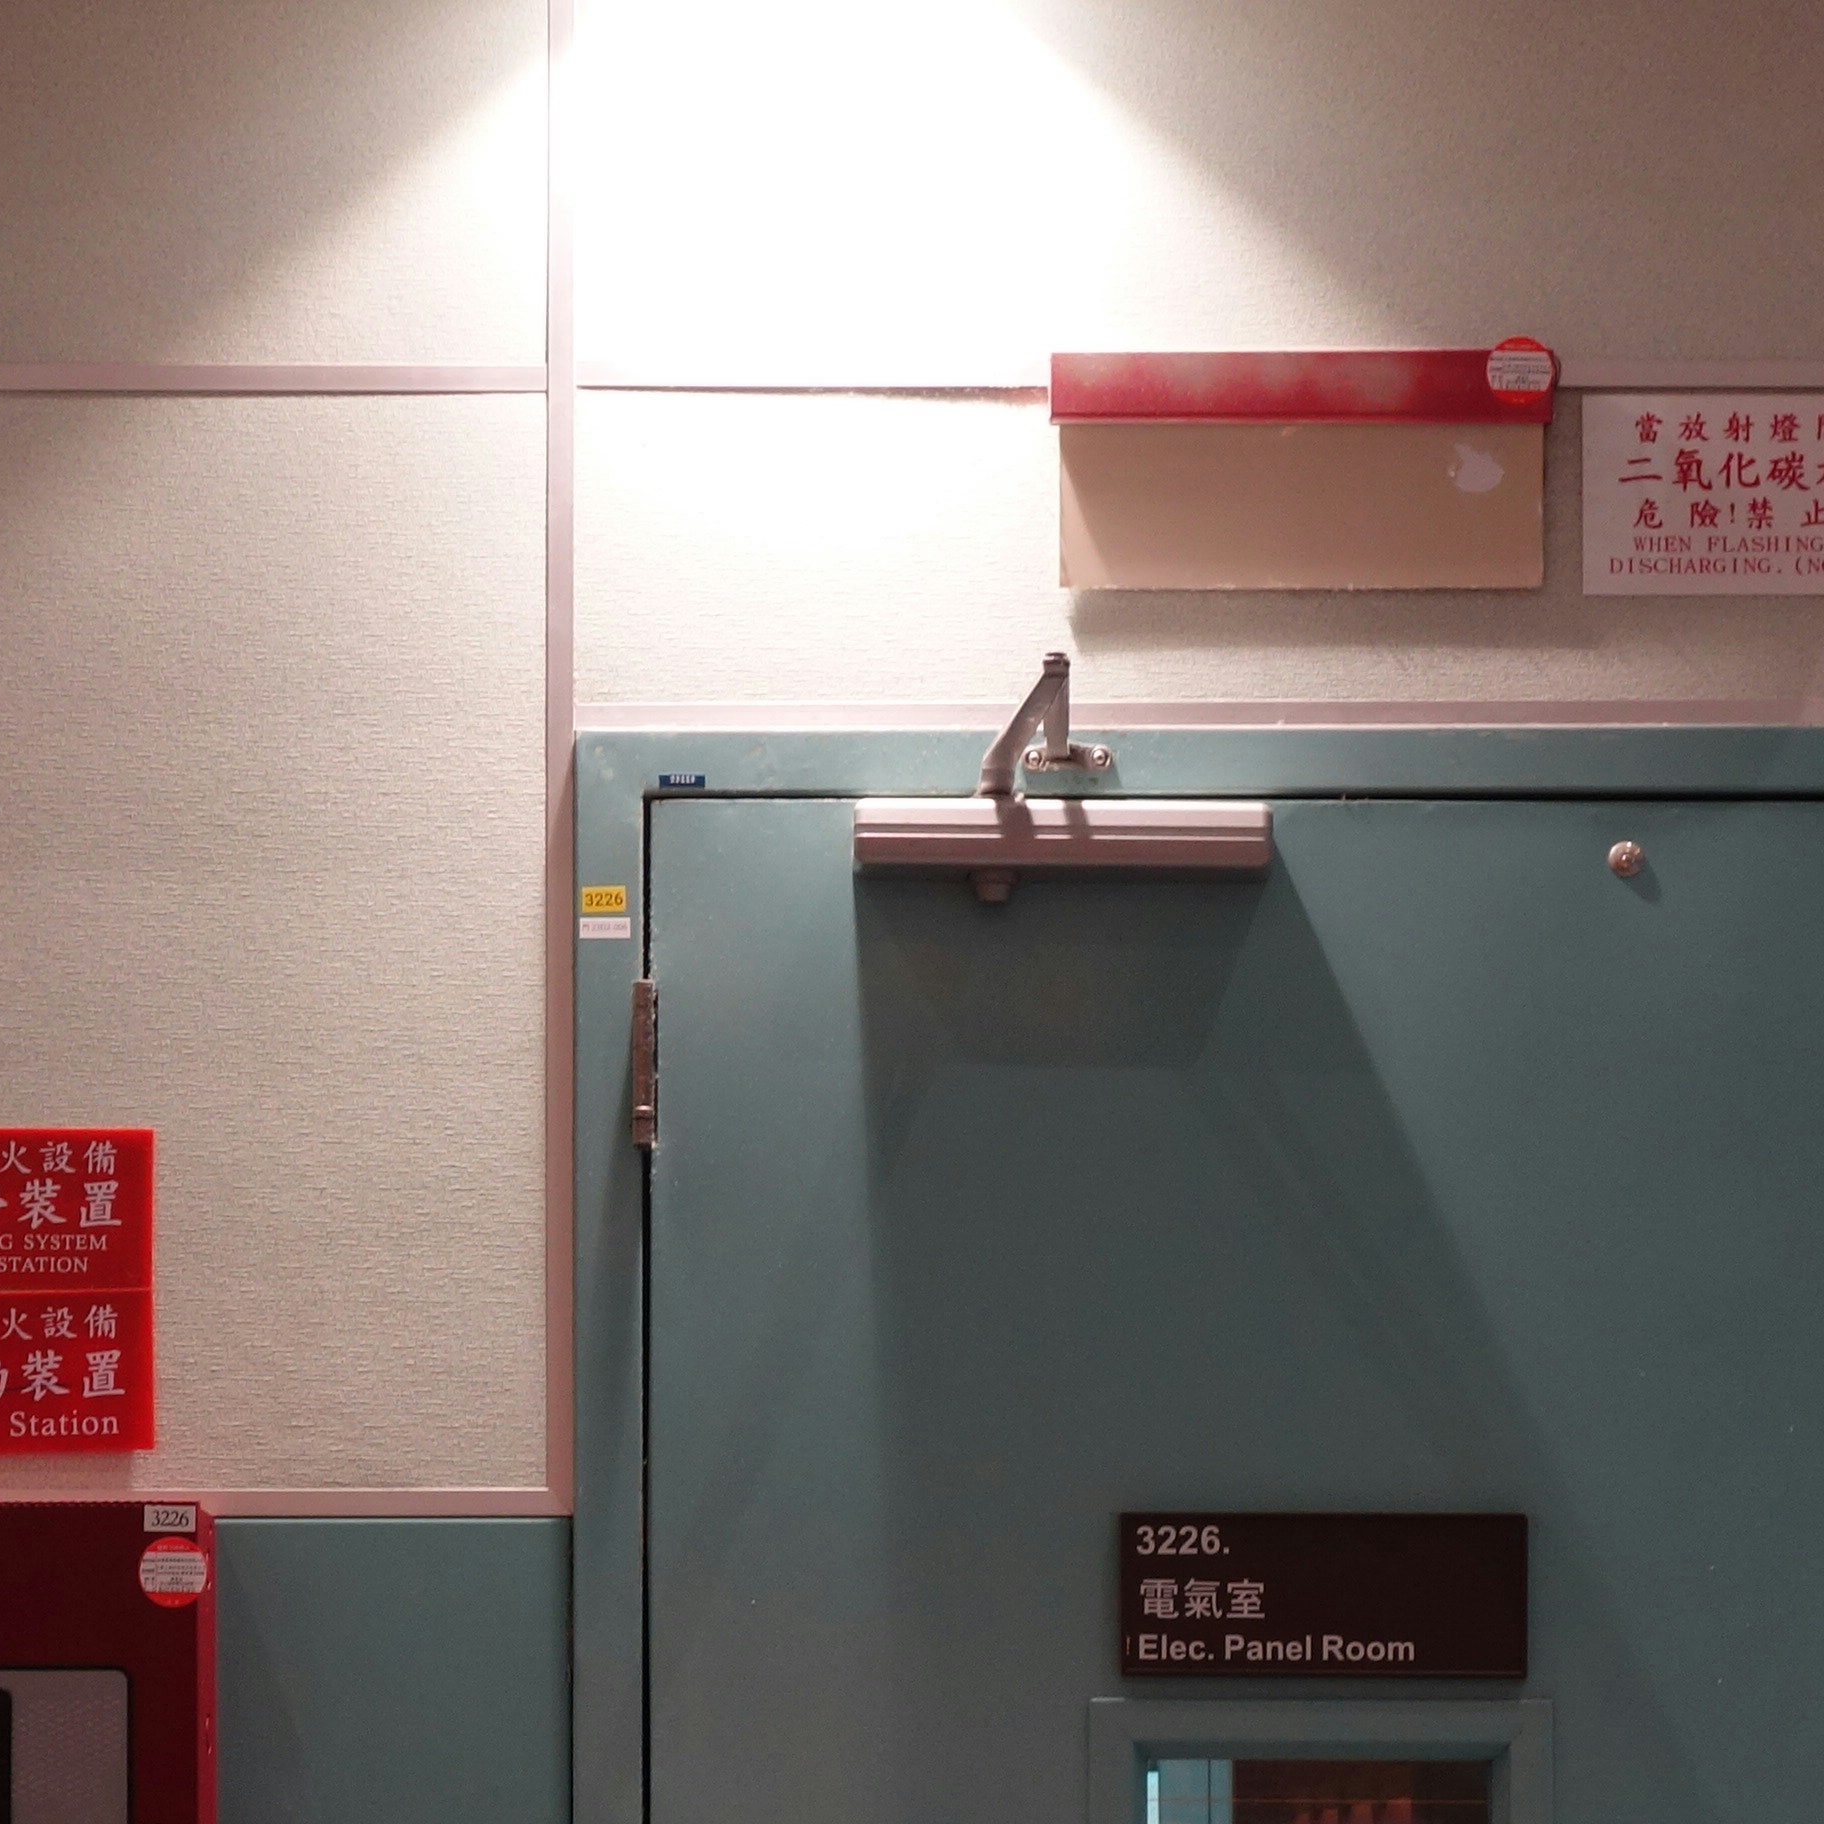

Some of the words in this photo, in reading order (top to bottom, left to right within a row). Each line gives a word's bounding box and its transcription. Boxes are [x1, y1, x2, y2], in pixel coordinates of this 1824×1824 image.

[1633, 536, 1692, 552] WHEN
[584, 891, 624, 907] 3226
[23, 1234, 107, 1250] SYSTEM
[9, 1409, 120, 1437] Station
[151, 1510, 189, 1528] 3226
[1135, 1525, 1230, 1556] 3226.
[1139, 1577, 1266, 1619] 電氣室
[1138, 1633, 1215, 1661] Elec.
[1224, 1633, 1312, 1661] Panel
[1321, 1634, 1416, 1662] Room
